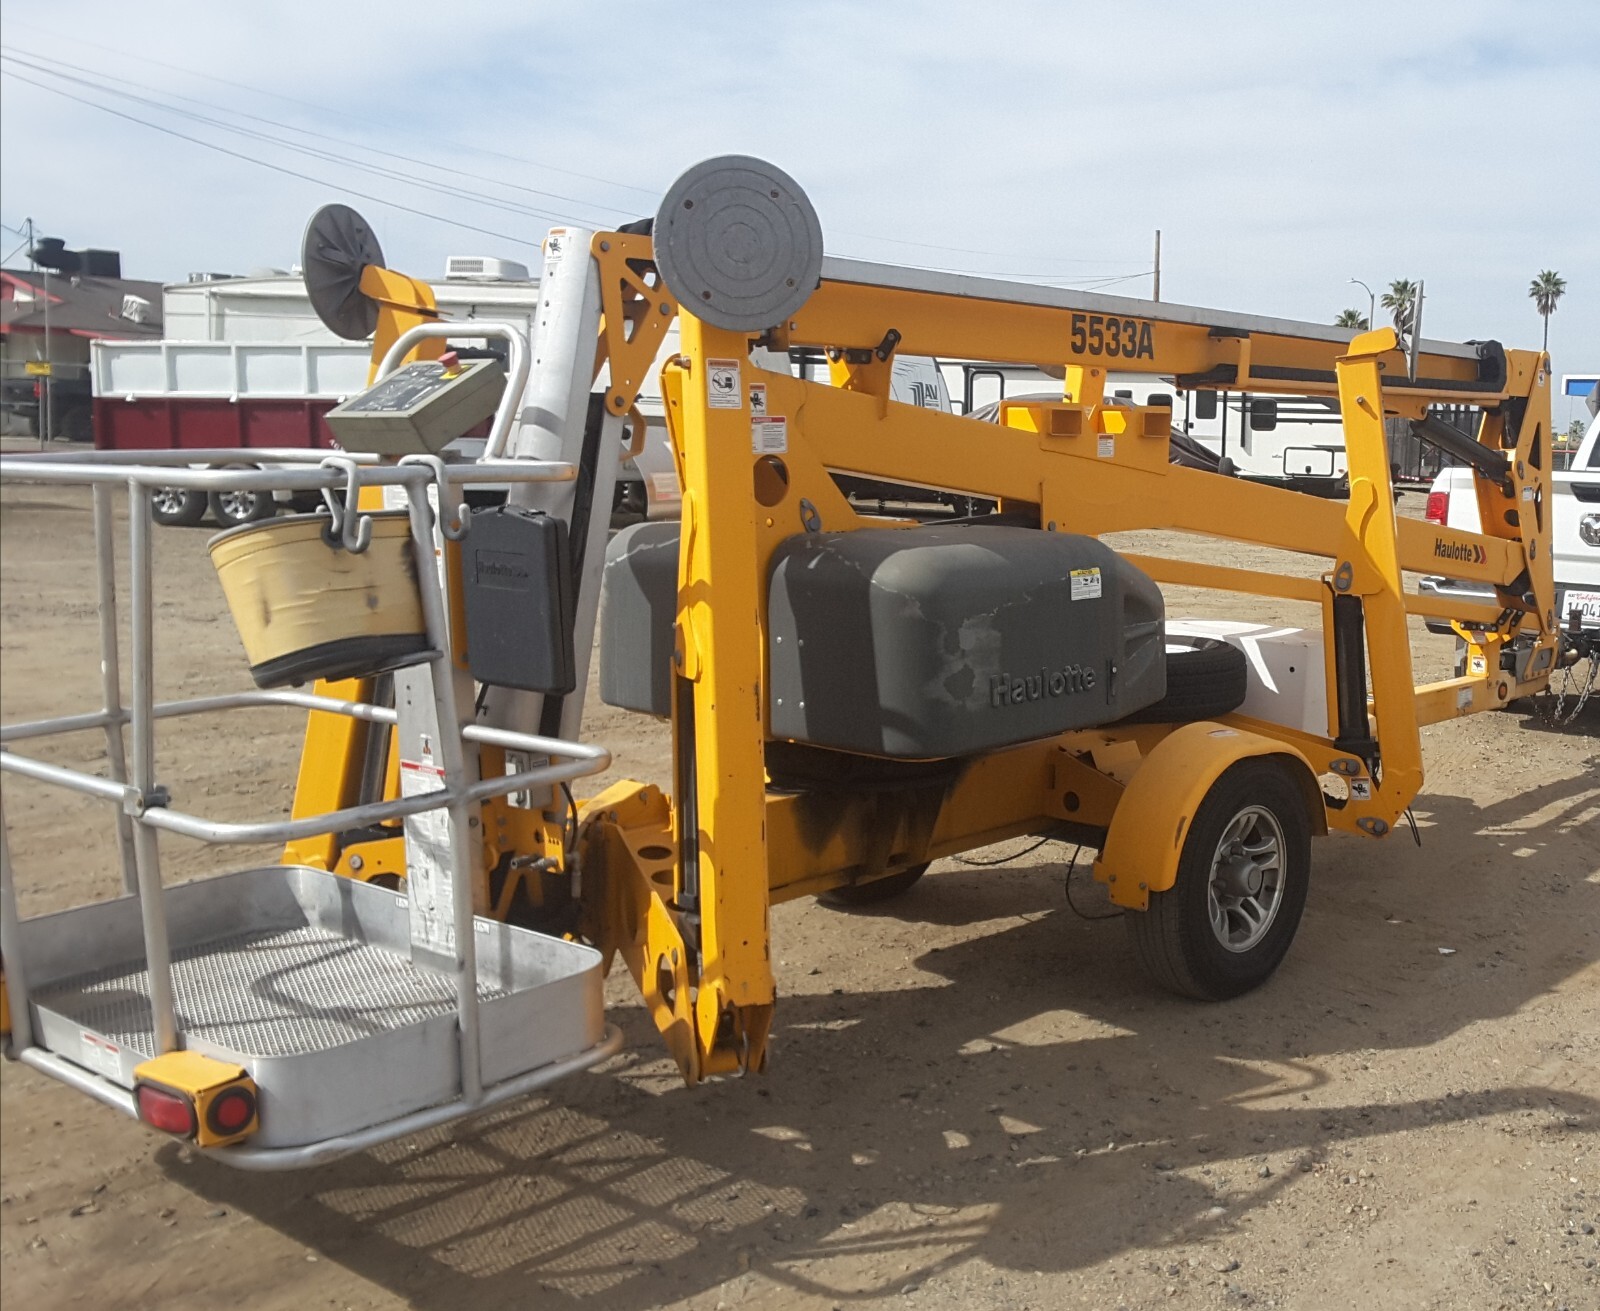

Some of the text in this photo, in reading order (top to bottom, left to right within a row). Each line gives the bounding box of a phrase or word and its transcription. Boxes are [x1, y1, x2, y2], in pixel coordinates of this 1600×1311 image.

[1071, 314, 1155, 360] 5533A
[1434, 537, 1473, 562] Haulotte
[989, 664, 1096, 708] Haulotte
